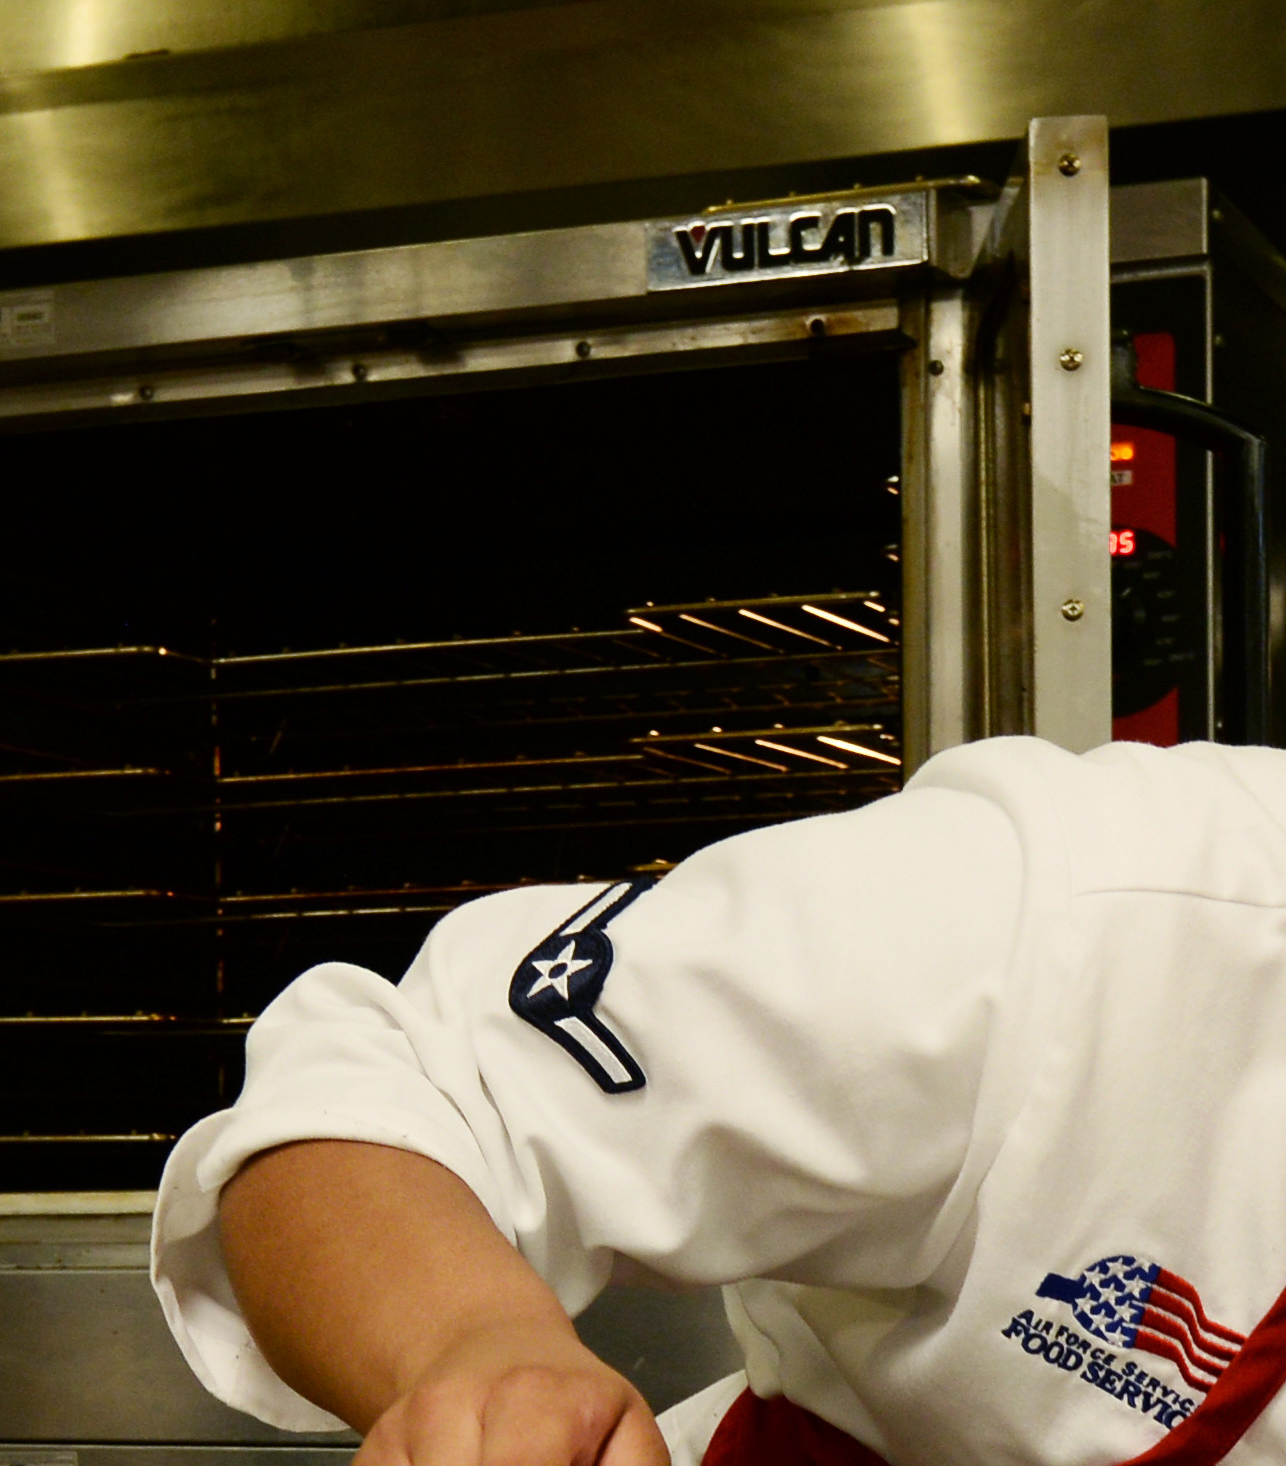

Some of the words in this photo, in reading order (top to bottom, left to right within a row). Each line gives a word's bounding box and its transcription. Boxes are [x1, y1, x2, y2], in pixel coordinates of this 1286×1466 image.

[672, 203, 896, 275] VULCAN
[1001, 1316, 1084, 1372] FOOD
[1016, 1309, 1054, 1336] AIR
[1054, 1324, 1118, 1367] FORCE
[1121, 1361, 1200, 1415] SERVIC
